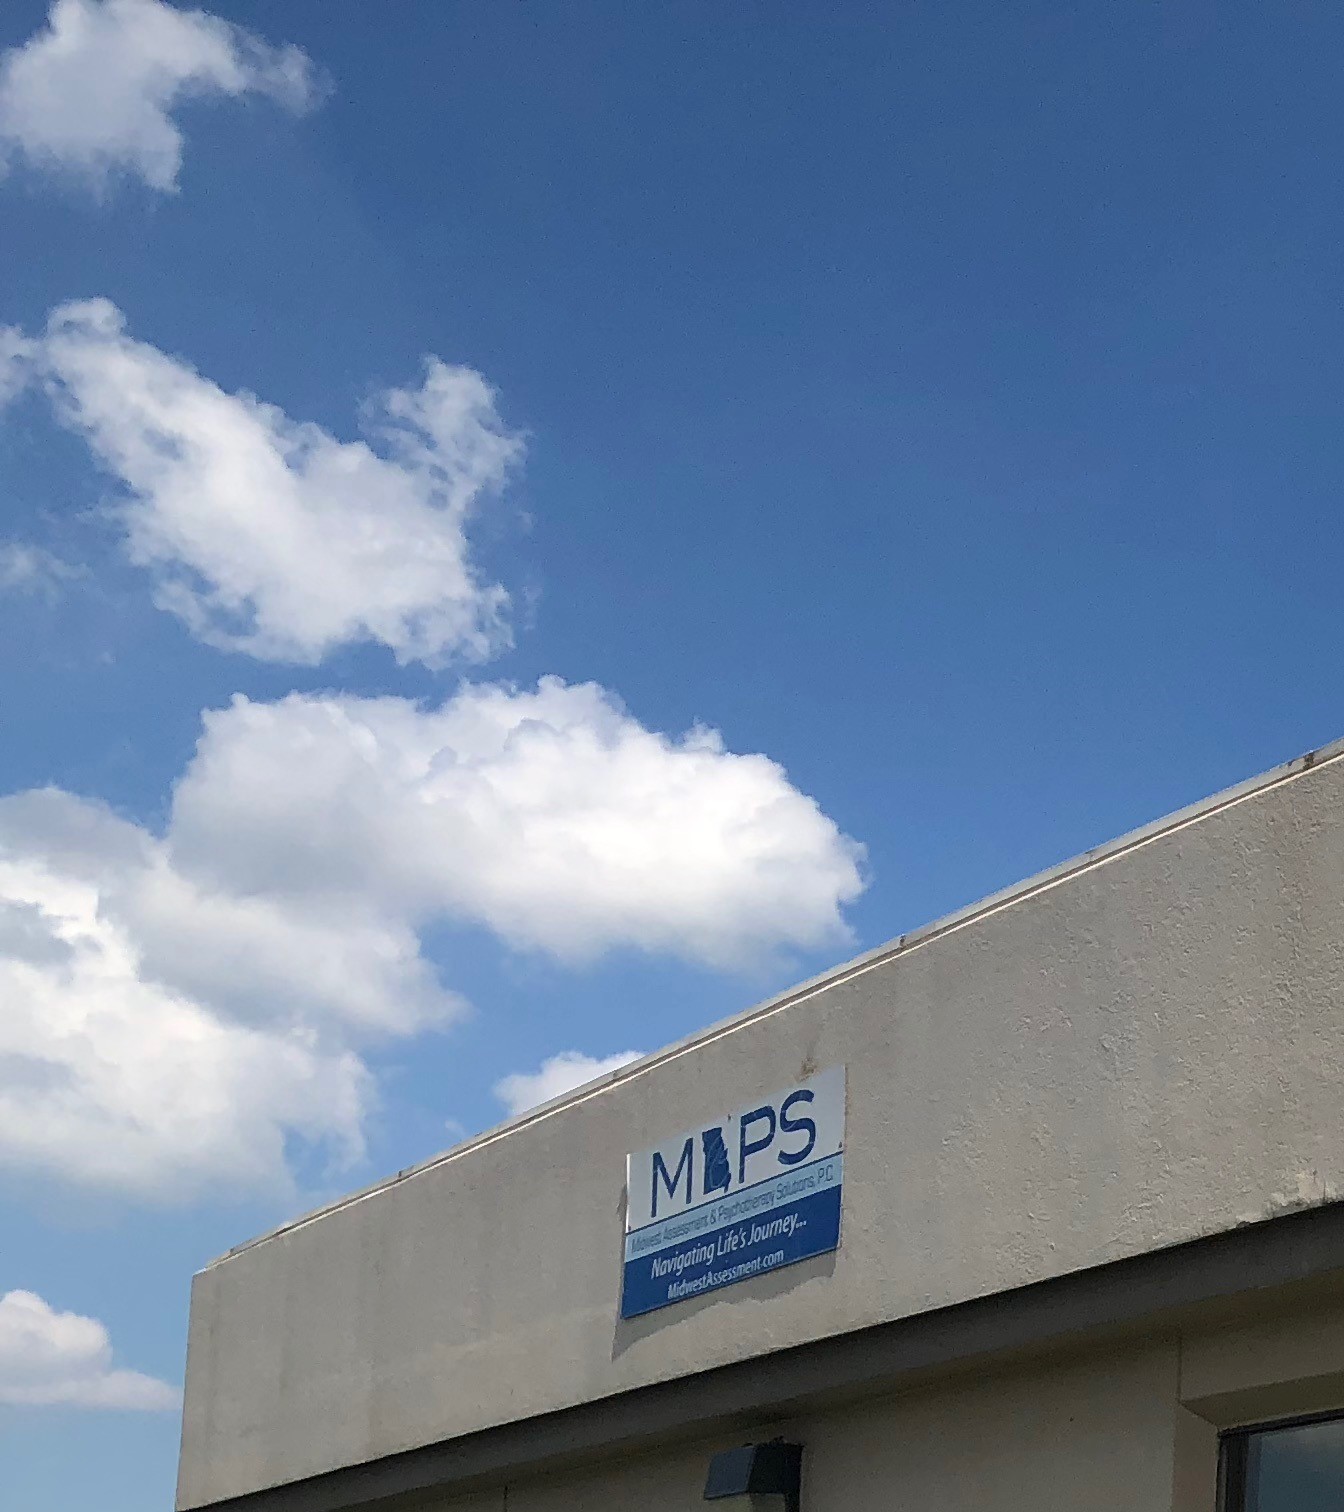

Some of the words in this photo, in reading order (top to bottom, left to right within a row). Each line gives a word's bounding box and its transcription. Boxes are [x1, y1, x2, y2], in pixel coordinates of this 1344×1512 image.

[651, 1090, 816, 1218] MPS
[651, 1242, 714, 1279] Navigating
[717, 1228, 745, 1256] Life's
[747, 1212, 807, 1246] Journey...
[667, 1250, 784, 1300] MidwestAssessment.com
